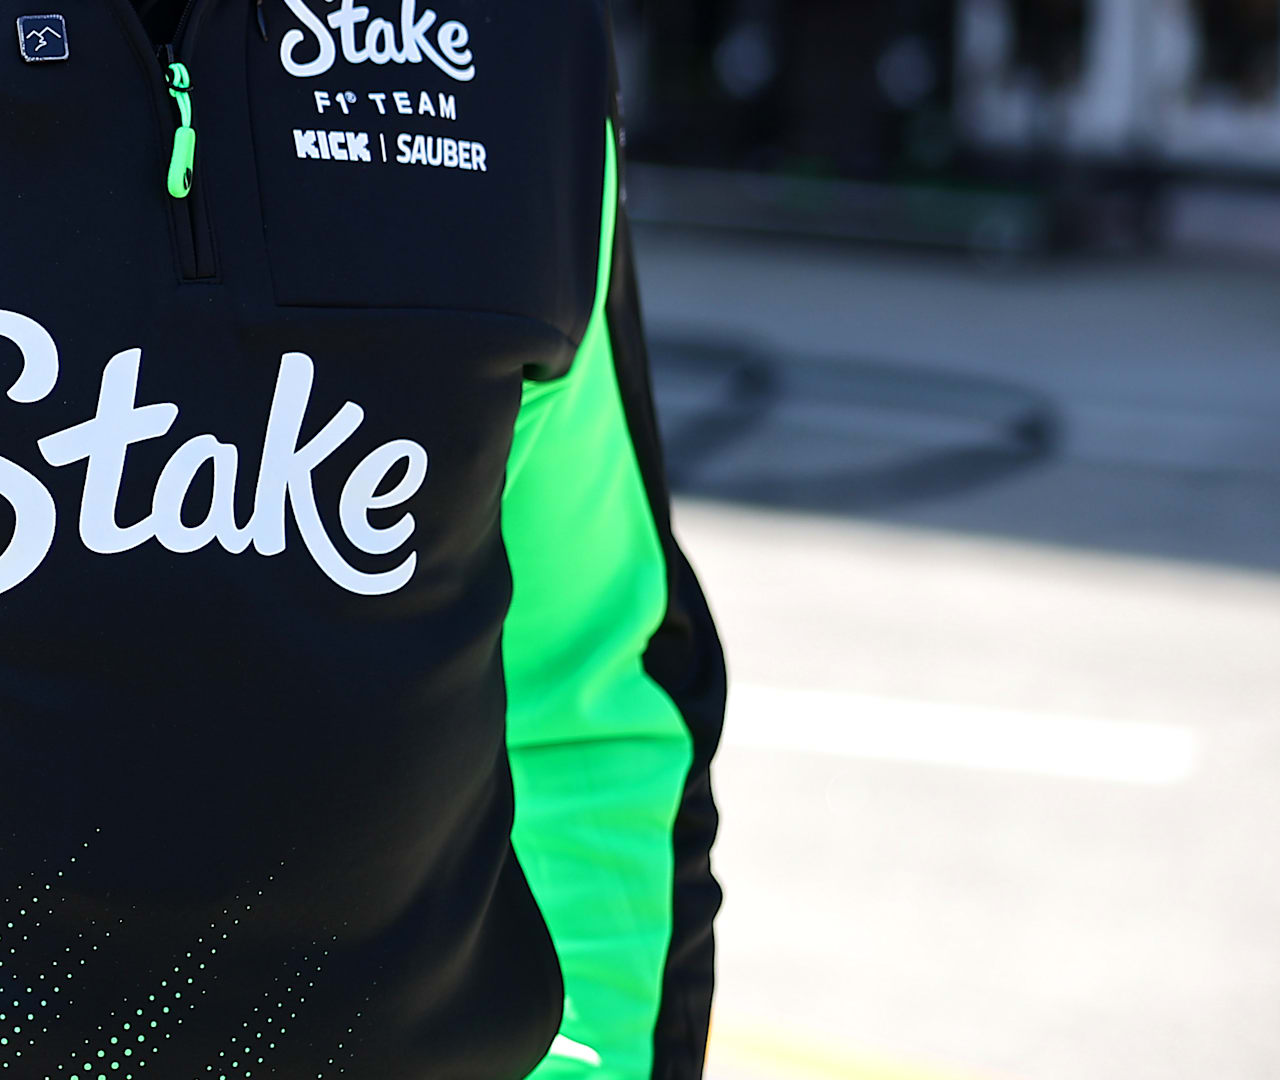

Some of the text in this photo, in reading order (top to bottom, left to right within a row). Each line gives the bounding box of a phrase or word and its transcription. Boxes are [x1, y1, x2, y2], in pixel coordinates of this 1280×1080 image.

[367, 90, 457, 121] TEAM
[292, 129, 488, 172] KICK SAUBER
